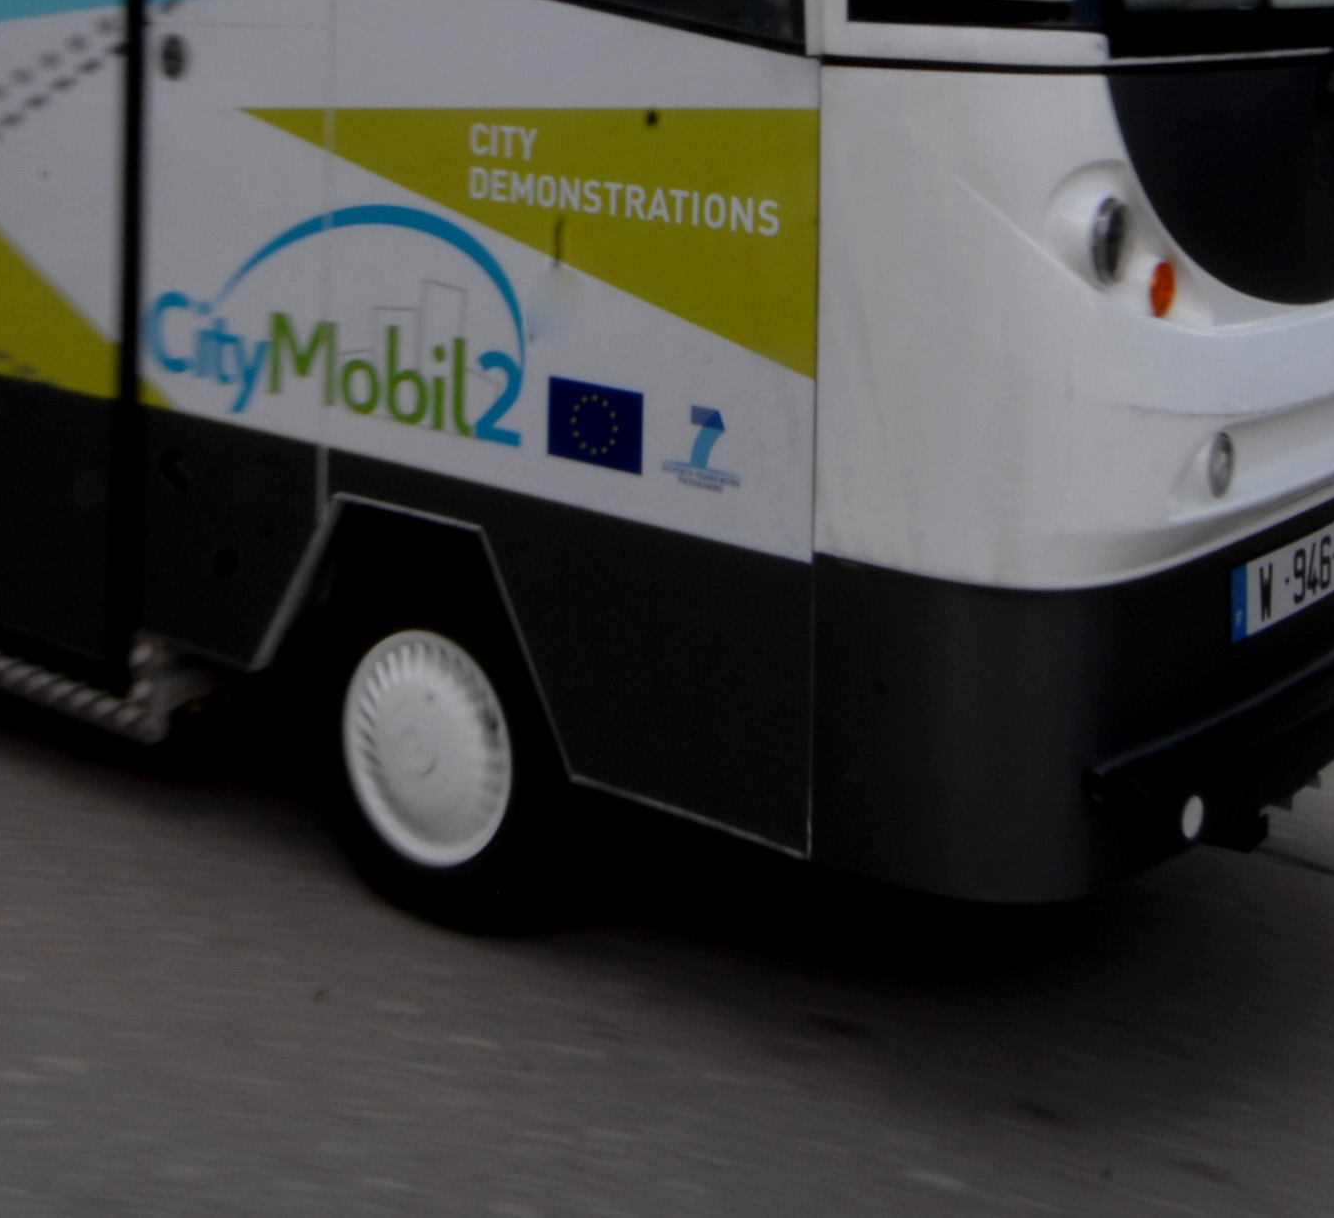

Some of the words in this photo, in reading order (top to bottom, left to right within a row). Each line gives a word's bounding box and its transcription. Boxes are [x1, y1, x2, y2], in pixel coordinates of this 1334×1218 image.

[469, 124, 537, 161] CITY
[468, 167, 780, 236] DEMONSTRATIONS
[144, 291, 522, 447] CityMobil2
